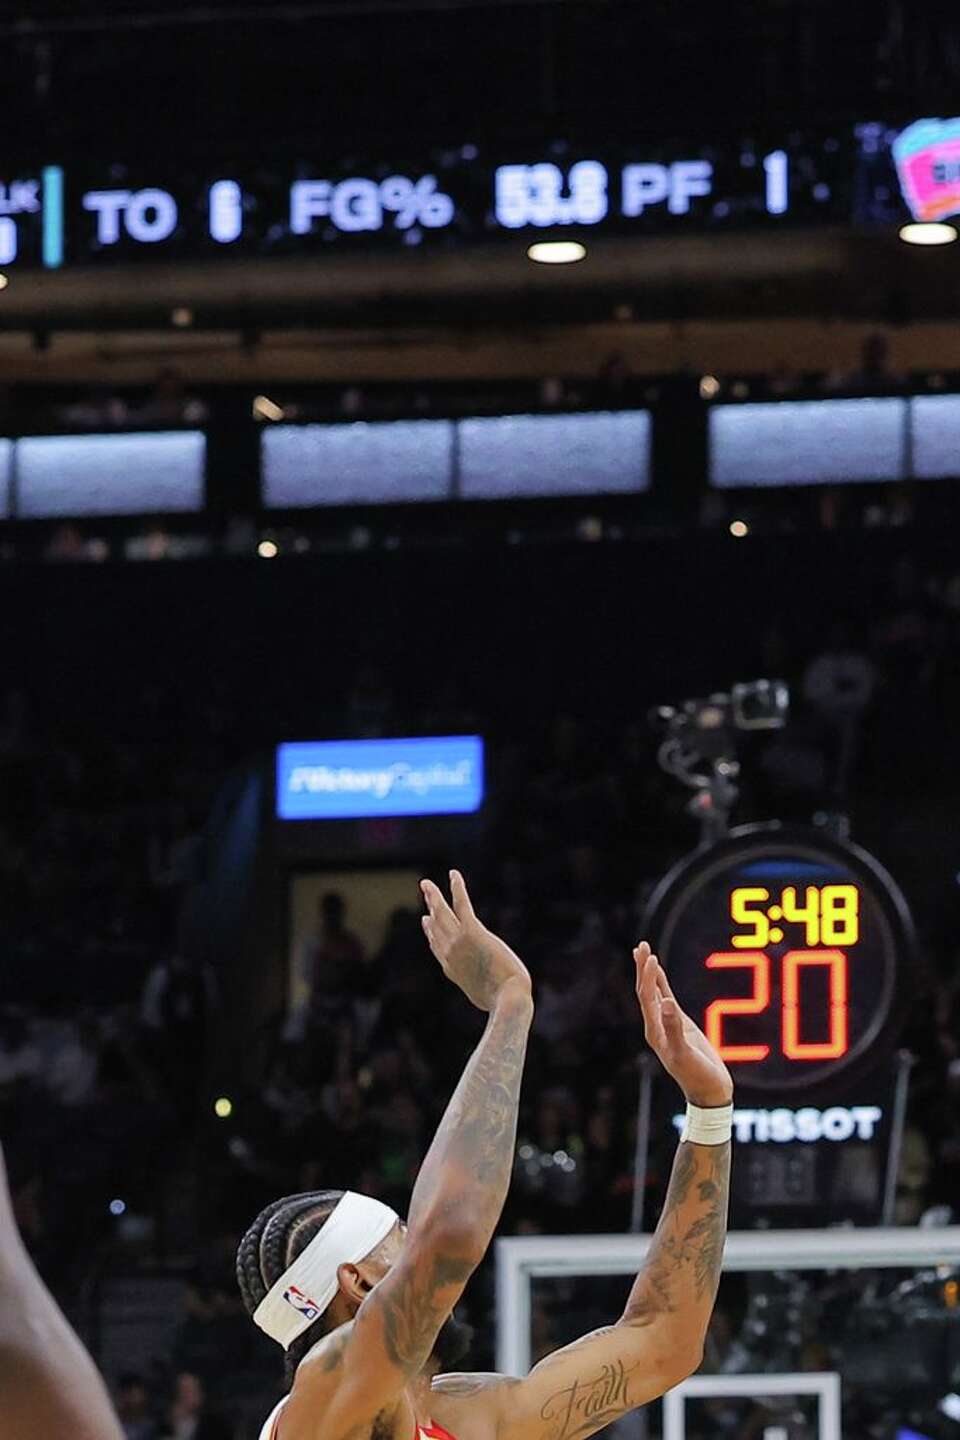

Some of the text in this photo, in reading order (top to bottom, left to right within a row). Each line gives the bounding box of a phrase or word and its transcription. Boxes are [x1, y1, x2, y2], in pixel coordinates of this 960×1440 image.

[83, 187, 178, 244] TO
[290, 175, 454, 234] FG%
[622, 160, 713, 217] PF
[764, 150, 788, 214] 1
[731, 884, 859, 949] 5:48
[705, 948, 848, 1062] 20
[733, 1105, 883, 1143] TISSOT
